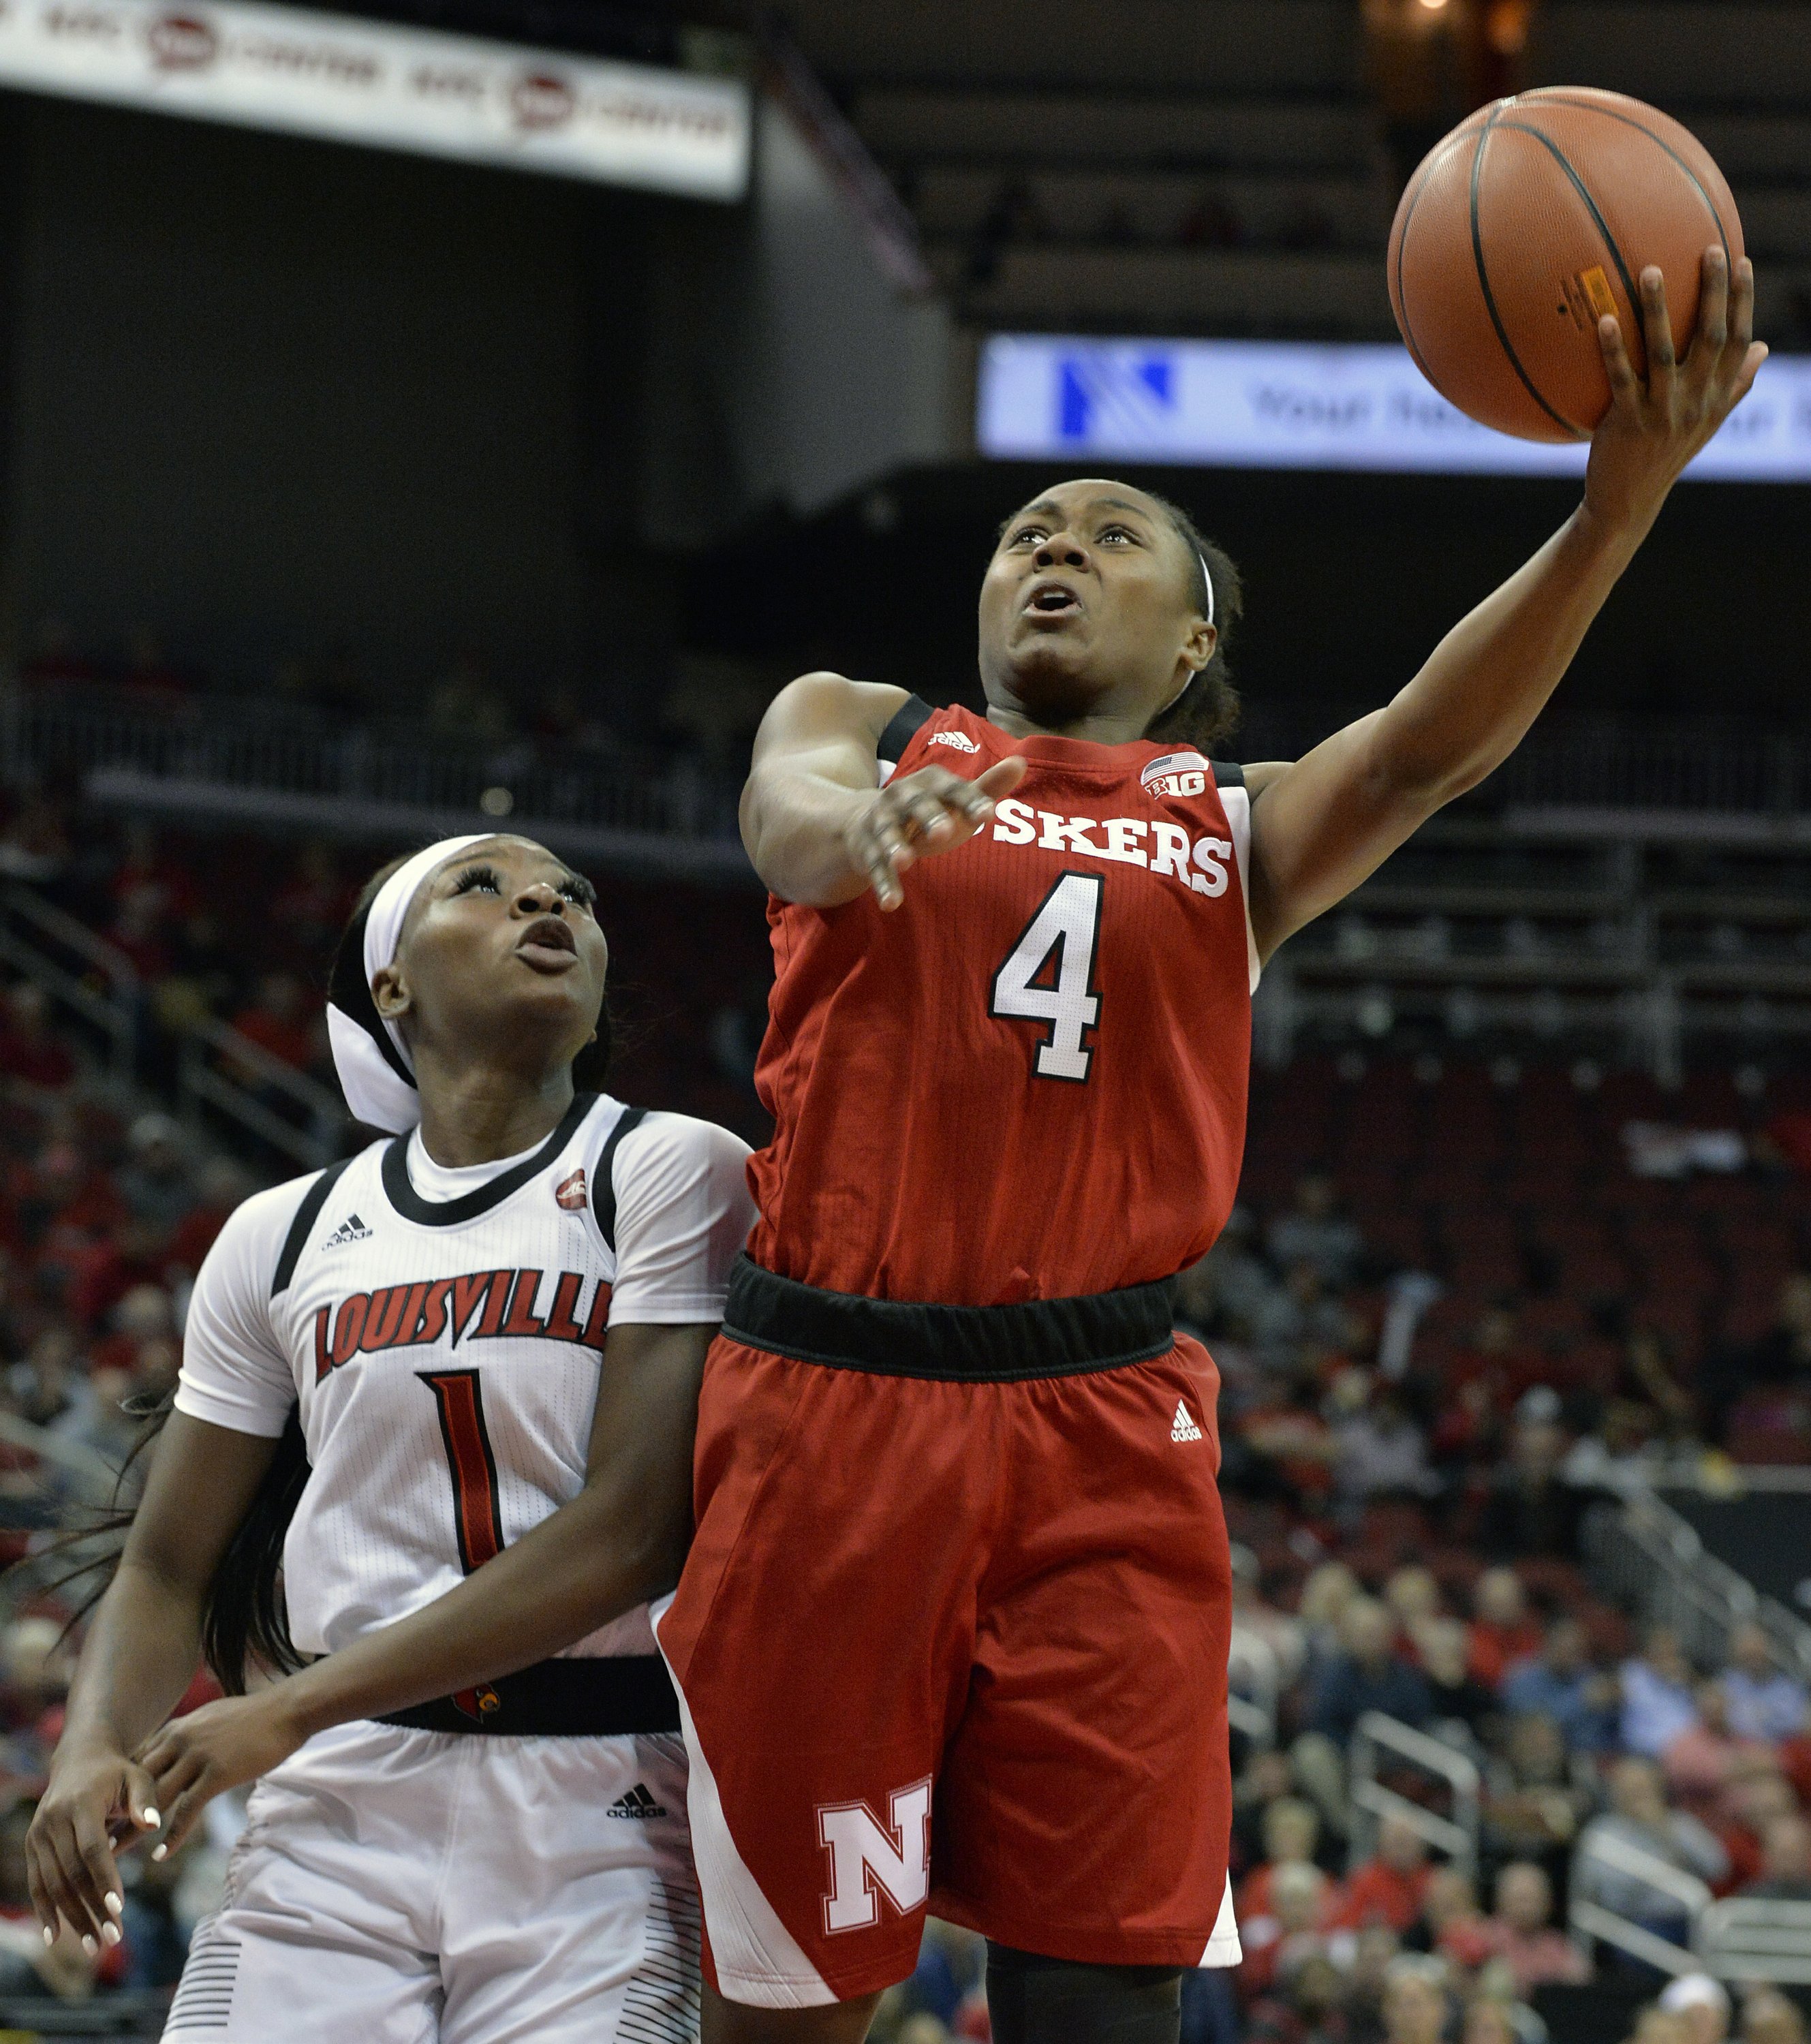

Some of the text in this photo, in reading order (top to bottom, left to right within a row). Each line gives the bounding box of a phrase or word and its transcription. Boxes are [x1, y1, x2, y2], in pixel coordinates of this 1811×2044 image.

[971, 799, 1232, 898] SKERS
[988, 869, 1105, 1084] 4
[414, 1368, 504, 1576] 1
[1171, 1426, 1203, 1442] adidas
[606, 1806, 667, 1818] adidas
[814, 1774, 933, 1936] N
